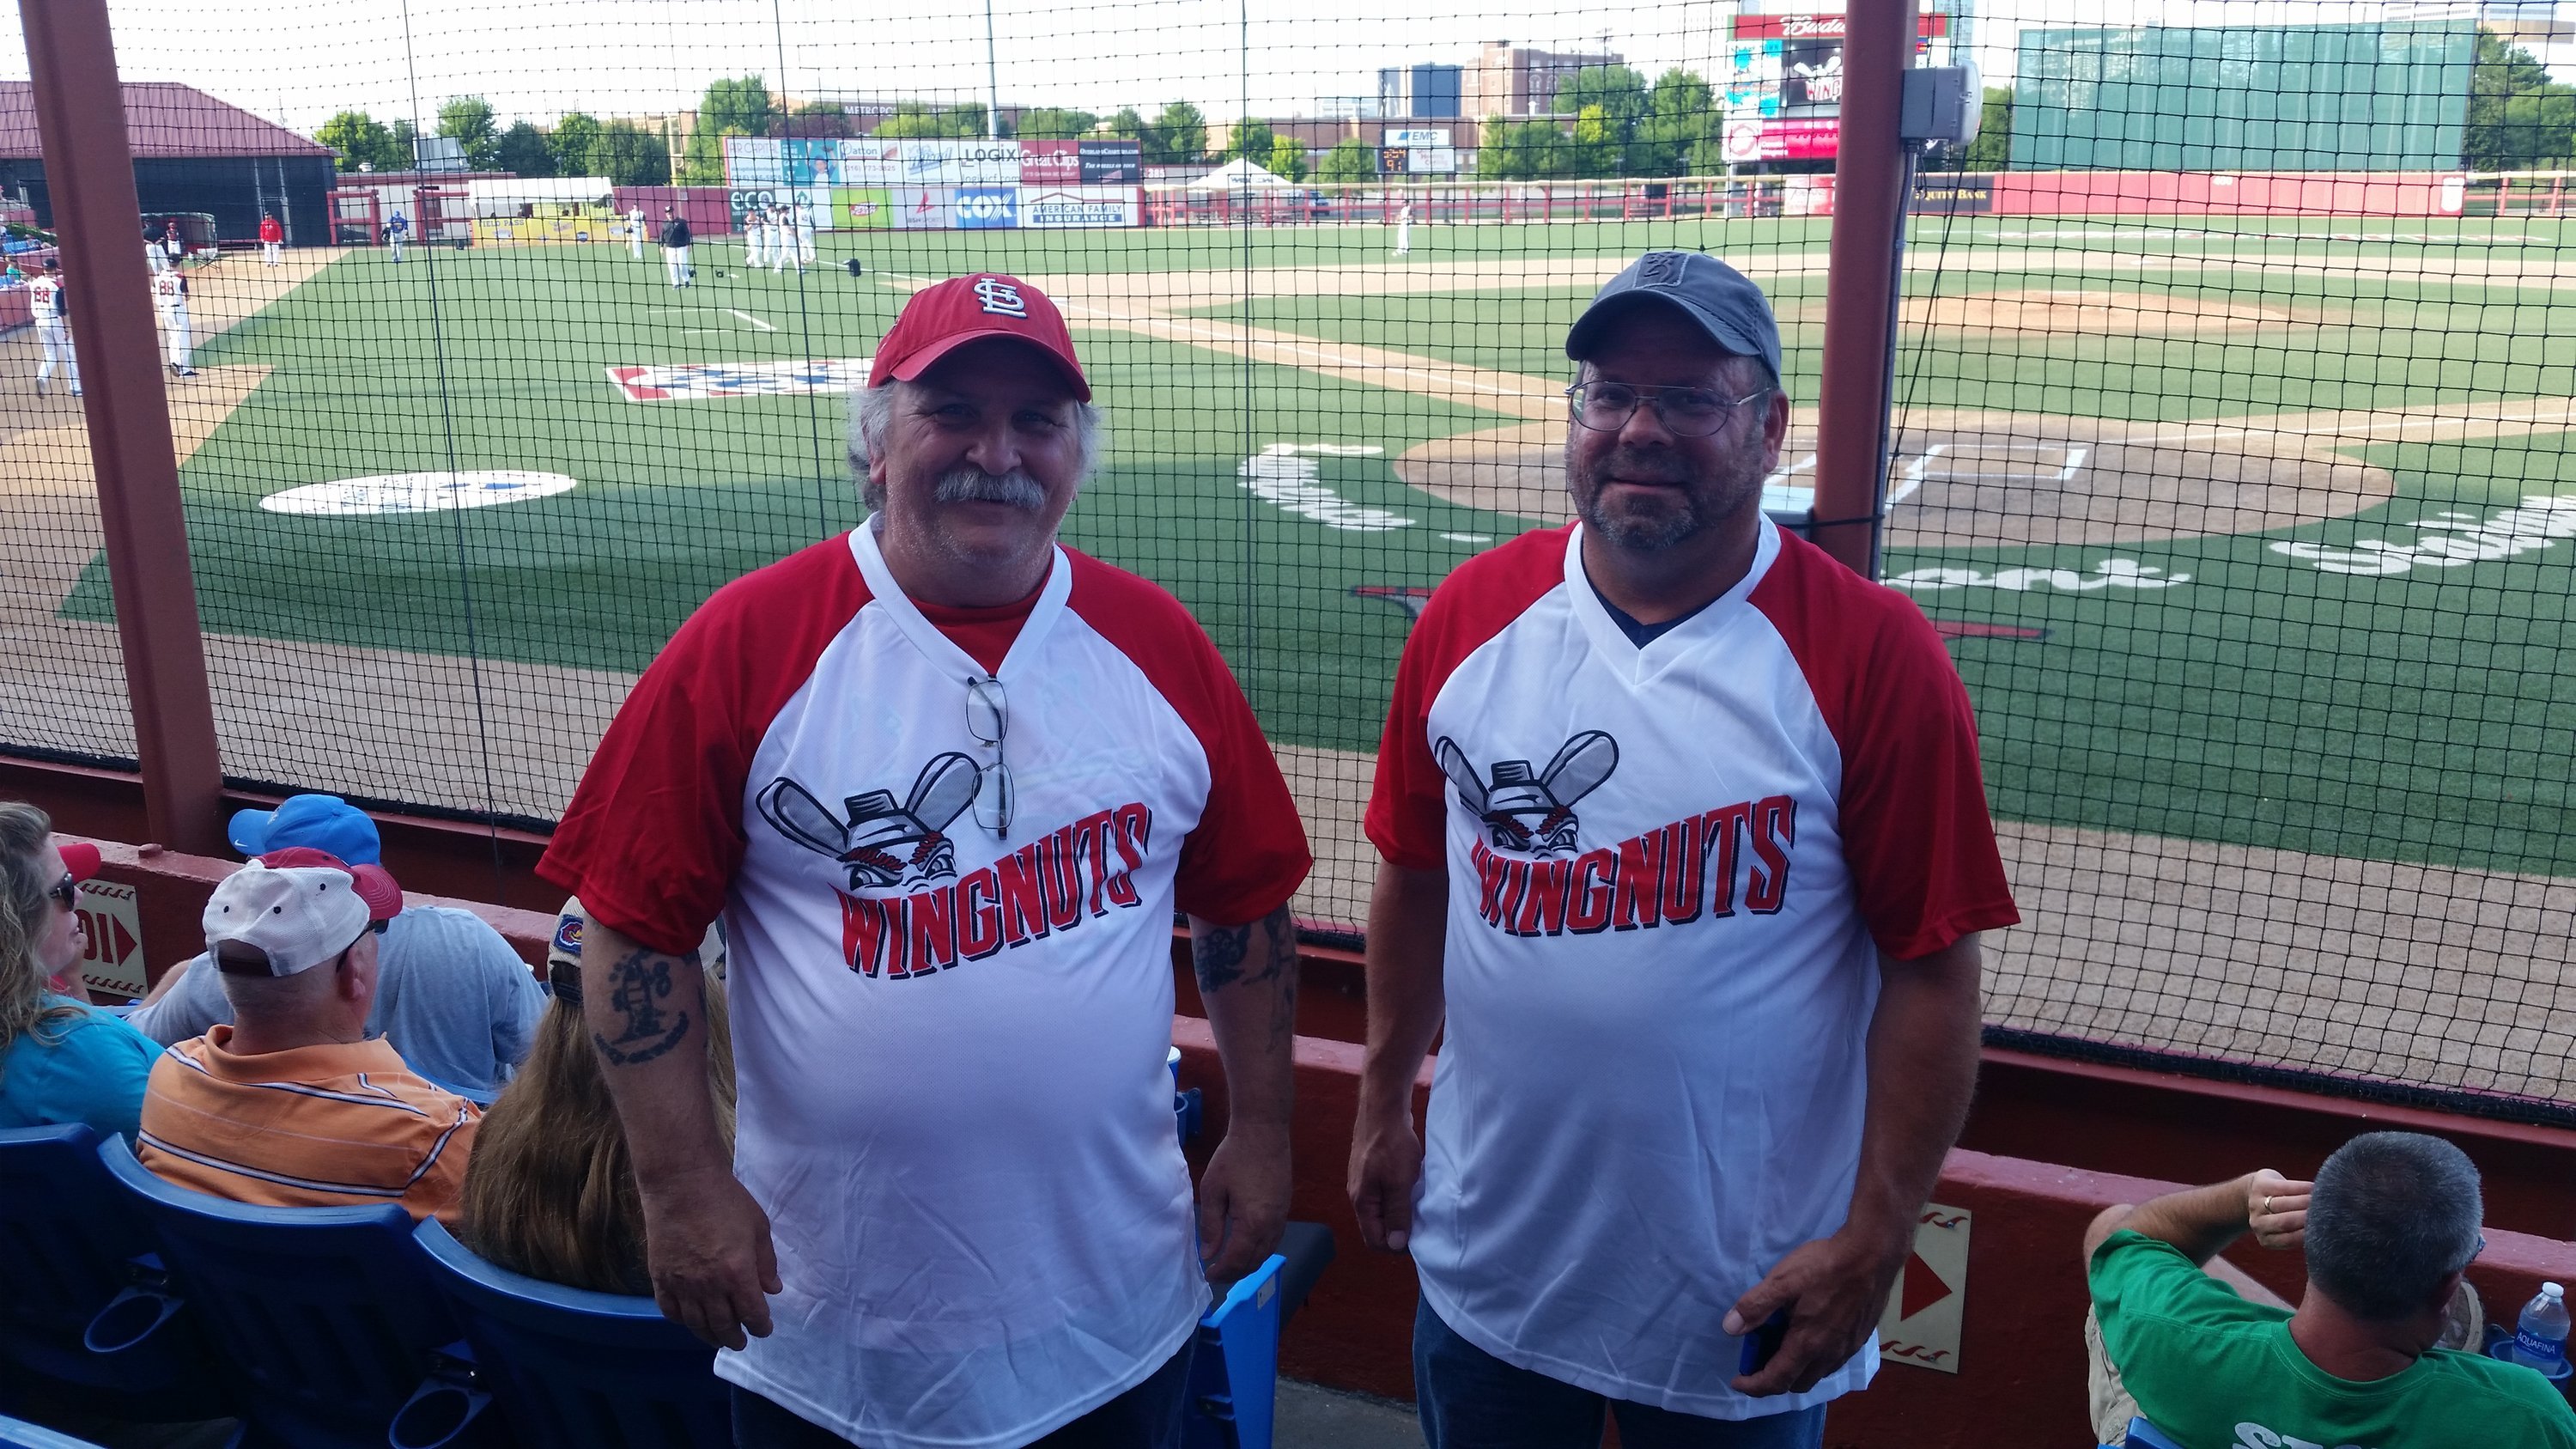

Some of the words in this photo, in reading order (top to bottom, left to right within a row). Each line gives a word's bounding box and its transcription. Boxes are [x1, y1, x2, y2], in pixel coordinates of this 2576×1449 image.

[1412, 131, 1438, 141] EMC
[1021, 149, 1052, 167] Great
[1053, 149, 1079, 171] Clips
[1958, 190, 1987, 199] BANK
[956, 193, 1014, 222] COX
[1032, 205, 1084, 214] AMERICAN
[1088, 204, 1122, 214] FAMILY
[1040, 214, 1116, 222] INSURANCE
[1470, 794, 1798, 938] WINGNUTS
[828, 801, 1152, 981] WINGNUTS
[2516, 1331, 2556, 1355] AQUAFINA
